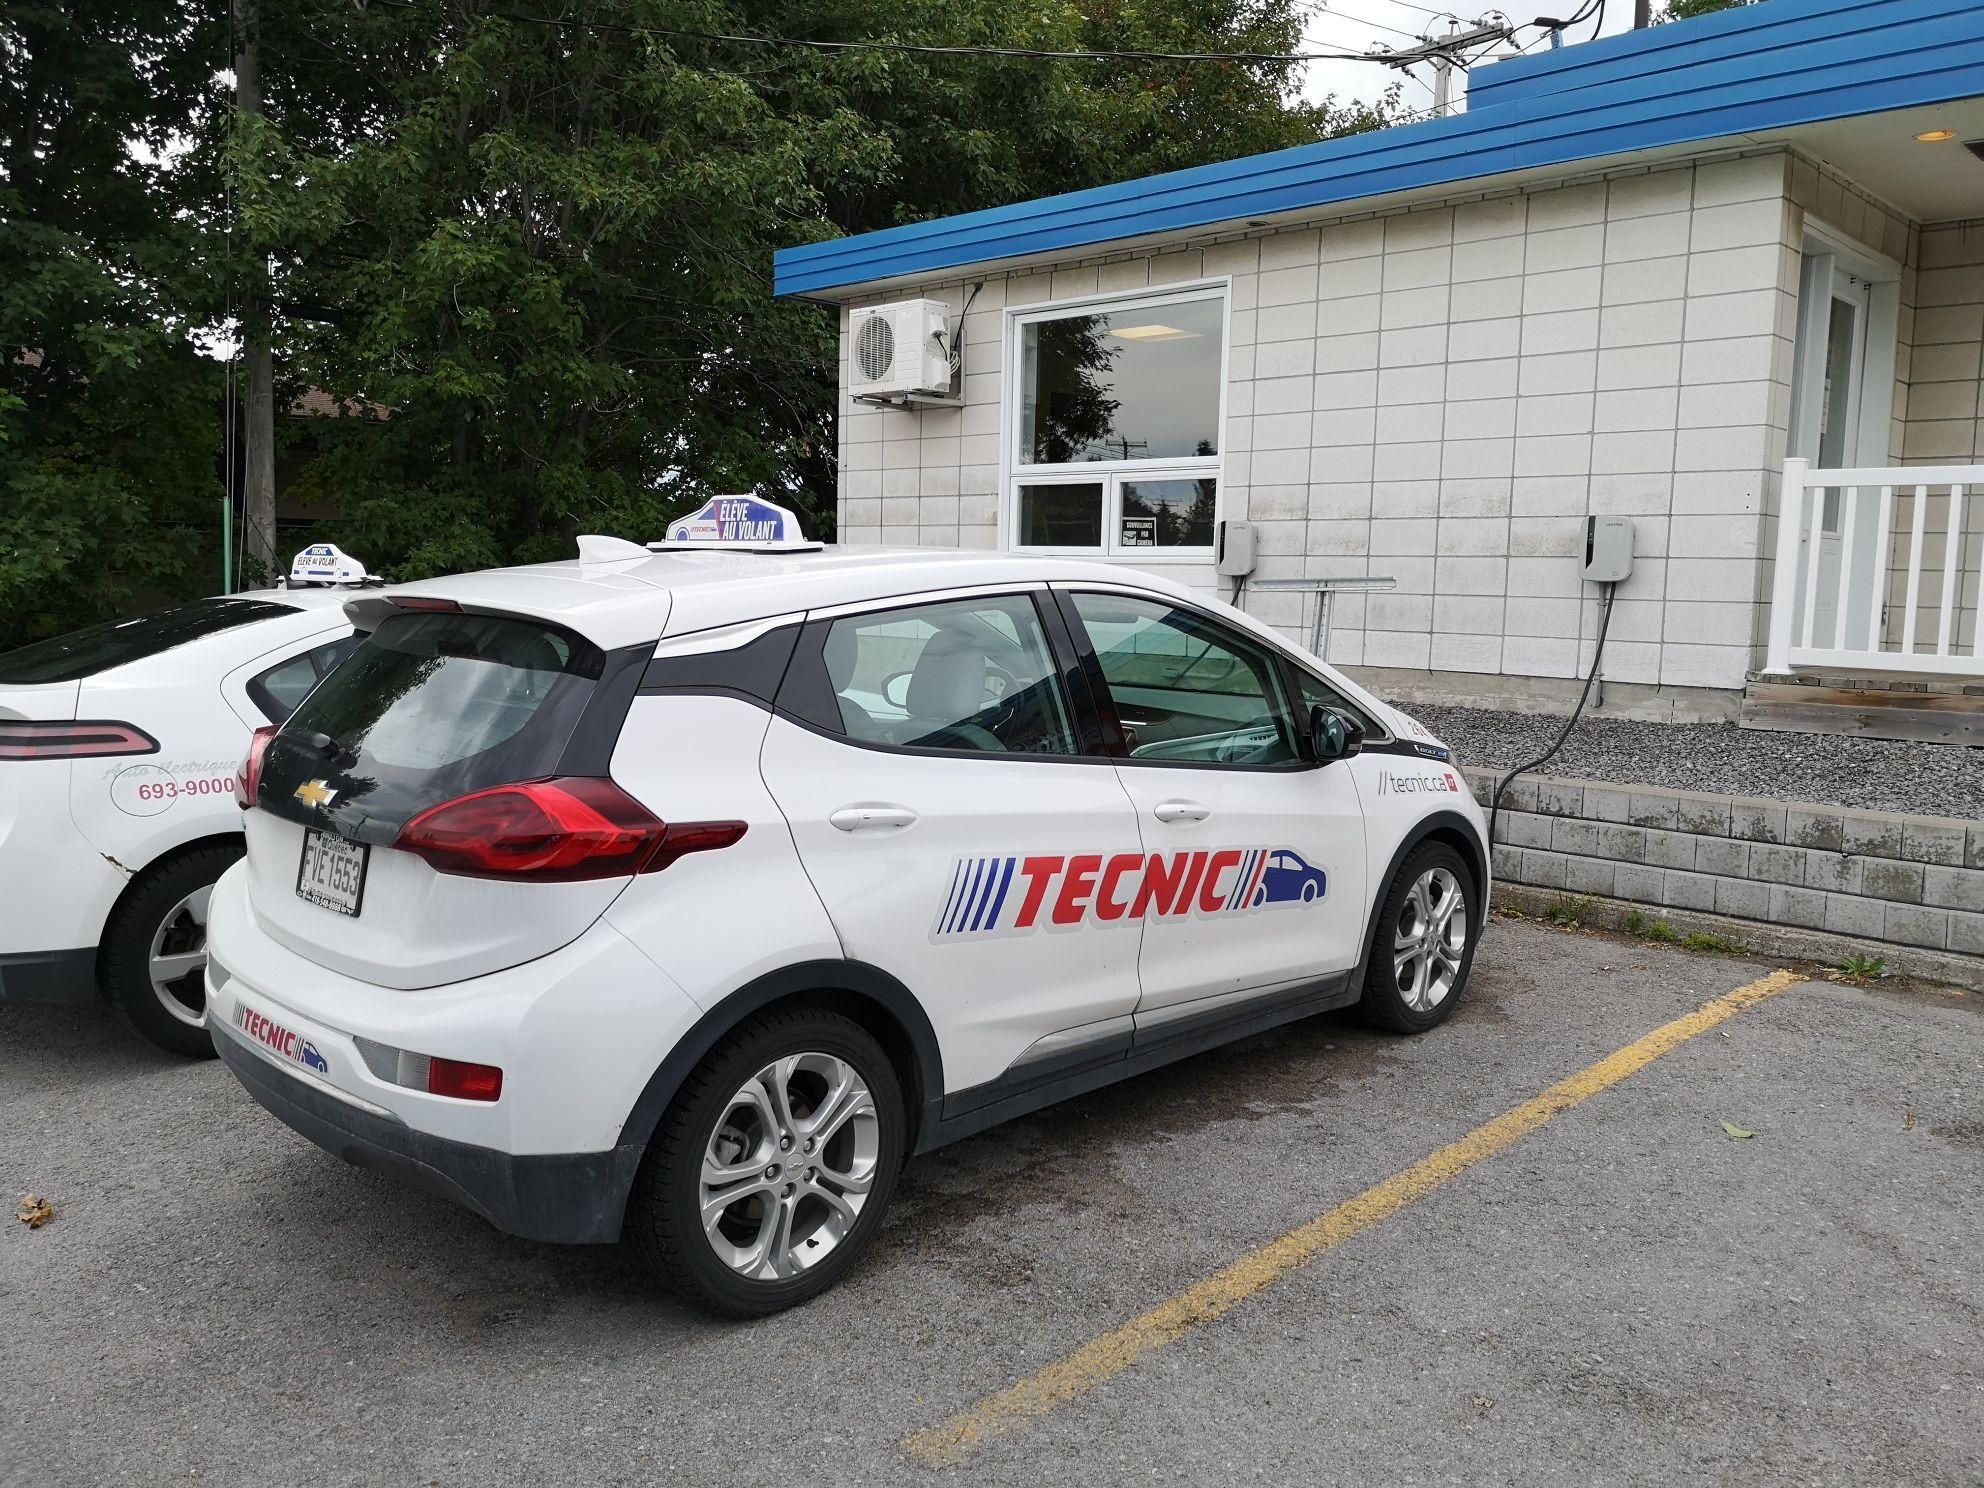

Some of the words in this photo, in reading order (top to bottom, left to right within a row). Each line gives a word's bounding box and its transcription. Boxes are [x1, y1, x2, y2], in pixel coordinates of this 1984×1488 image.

[719, 500, 750, 522] ÉLÈVE
[722, 521, 737, 541] AU
[738, 520, 778, 540] VOLANT
[318, 557, 338, 566] VOLANT
[138, 777, 236, 801] 693-9000
[1014, 850, 1243, 927] TECNIC
[244, 1007, 297, 1057] TECNIC
